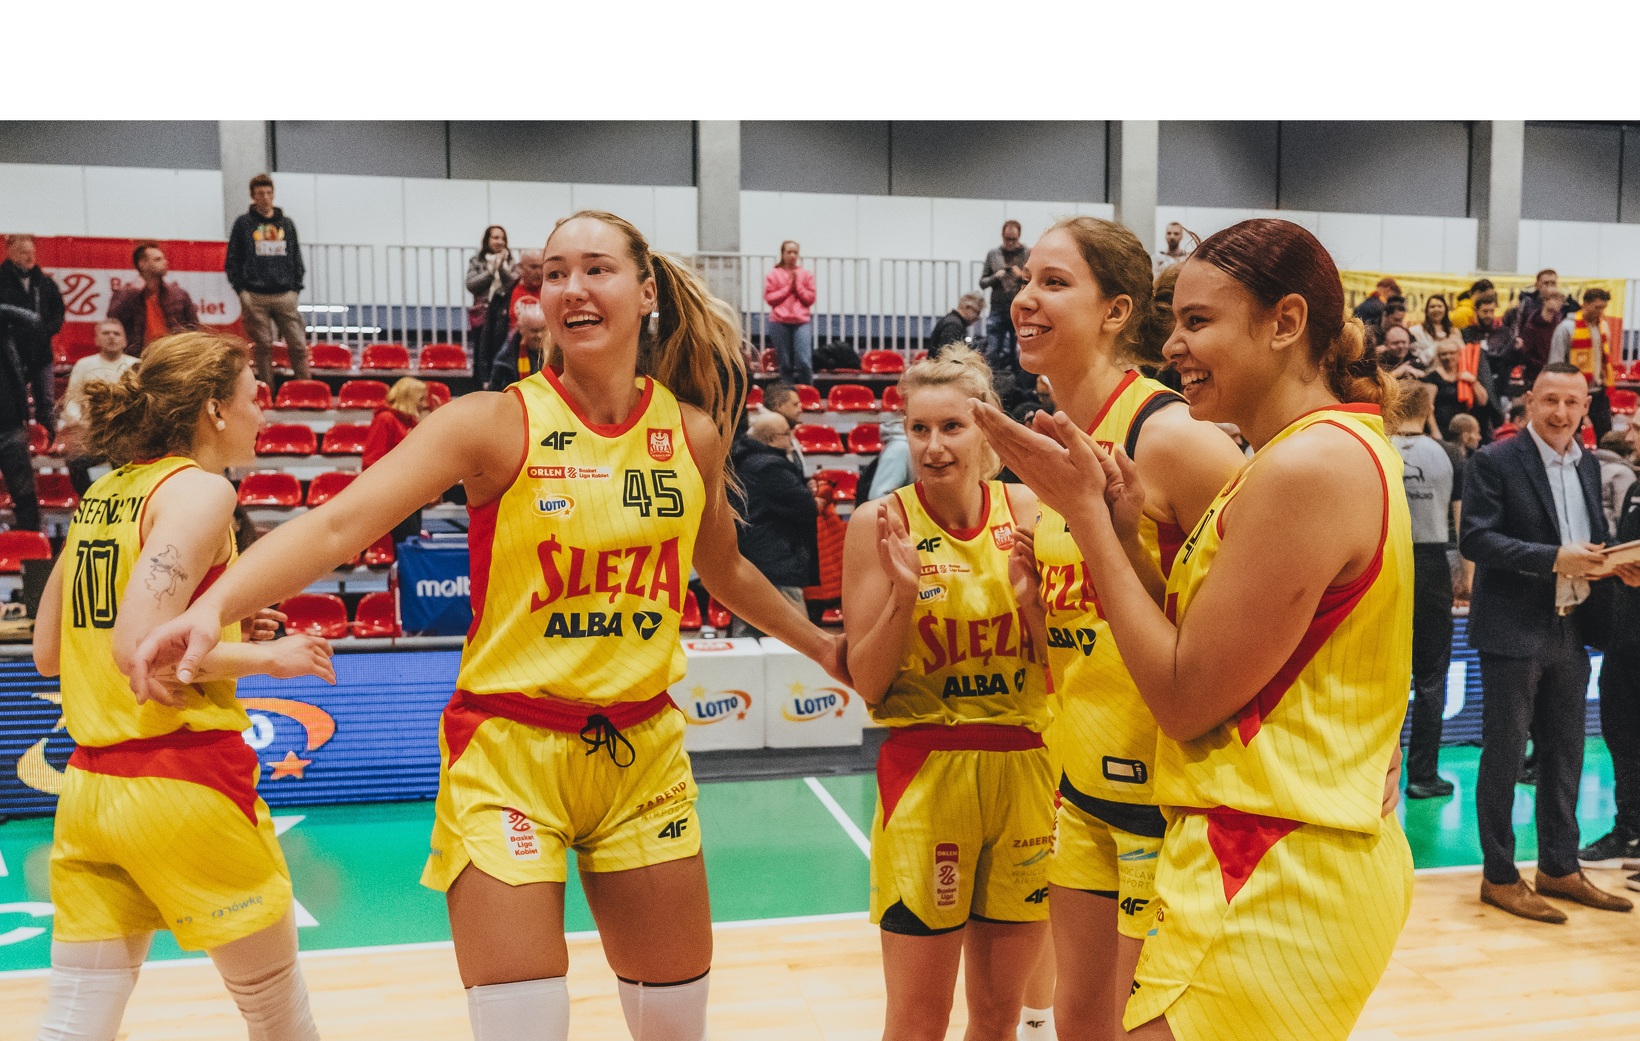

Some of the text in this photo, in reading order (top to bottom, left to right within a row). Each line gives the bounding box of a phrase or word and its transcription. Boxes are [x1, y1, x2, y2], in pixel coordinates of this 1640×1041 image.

[541, 431, 577, 451] 4F
[530, 469, 562, 477] ORLEN
[623, 469, 684, 518] 45
[540, 499, 566, 512] LOTTO
[916, 537, 942, 553] 4F
[530, 533, 681, 614] ŚLĘZA
[921, 566, 936, 574] LEN
[72, 538, 119, 629] 10
[416, 575, 471, 597] molt
[919, 587, 941, 600] LOTTO
[543, 611, 624, 638] ALBA
[917, 607, 1036, 676] ŚLĘZA
[1047, 627, 1080, 651] LBA
[942, 673, 1010, 699] ALBA
[695, 696, 738, 719] LOTTO
[794, 694, 837, 715] LOTTO
[510, 834, 534, 842] Basket
[658, 817, 688, 839] 4F
[515, 848, 538, 856] Kobiet
[1024, 887, 1049, 904] 4F
[1120, 897, 1150, 917] 4F
[1026, 1020, 1045, 1029] 4F
